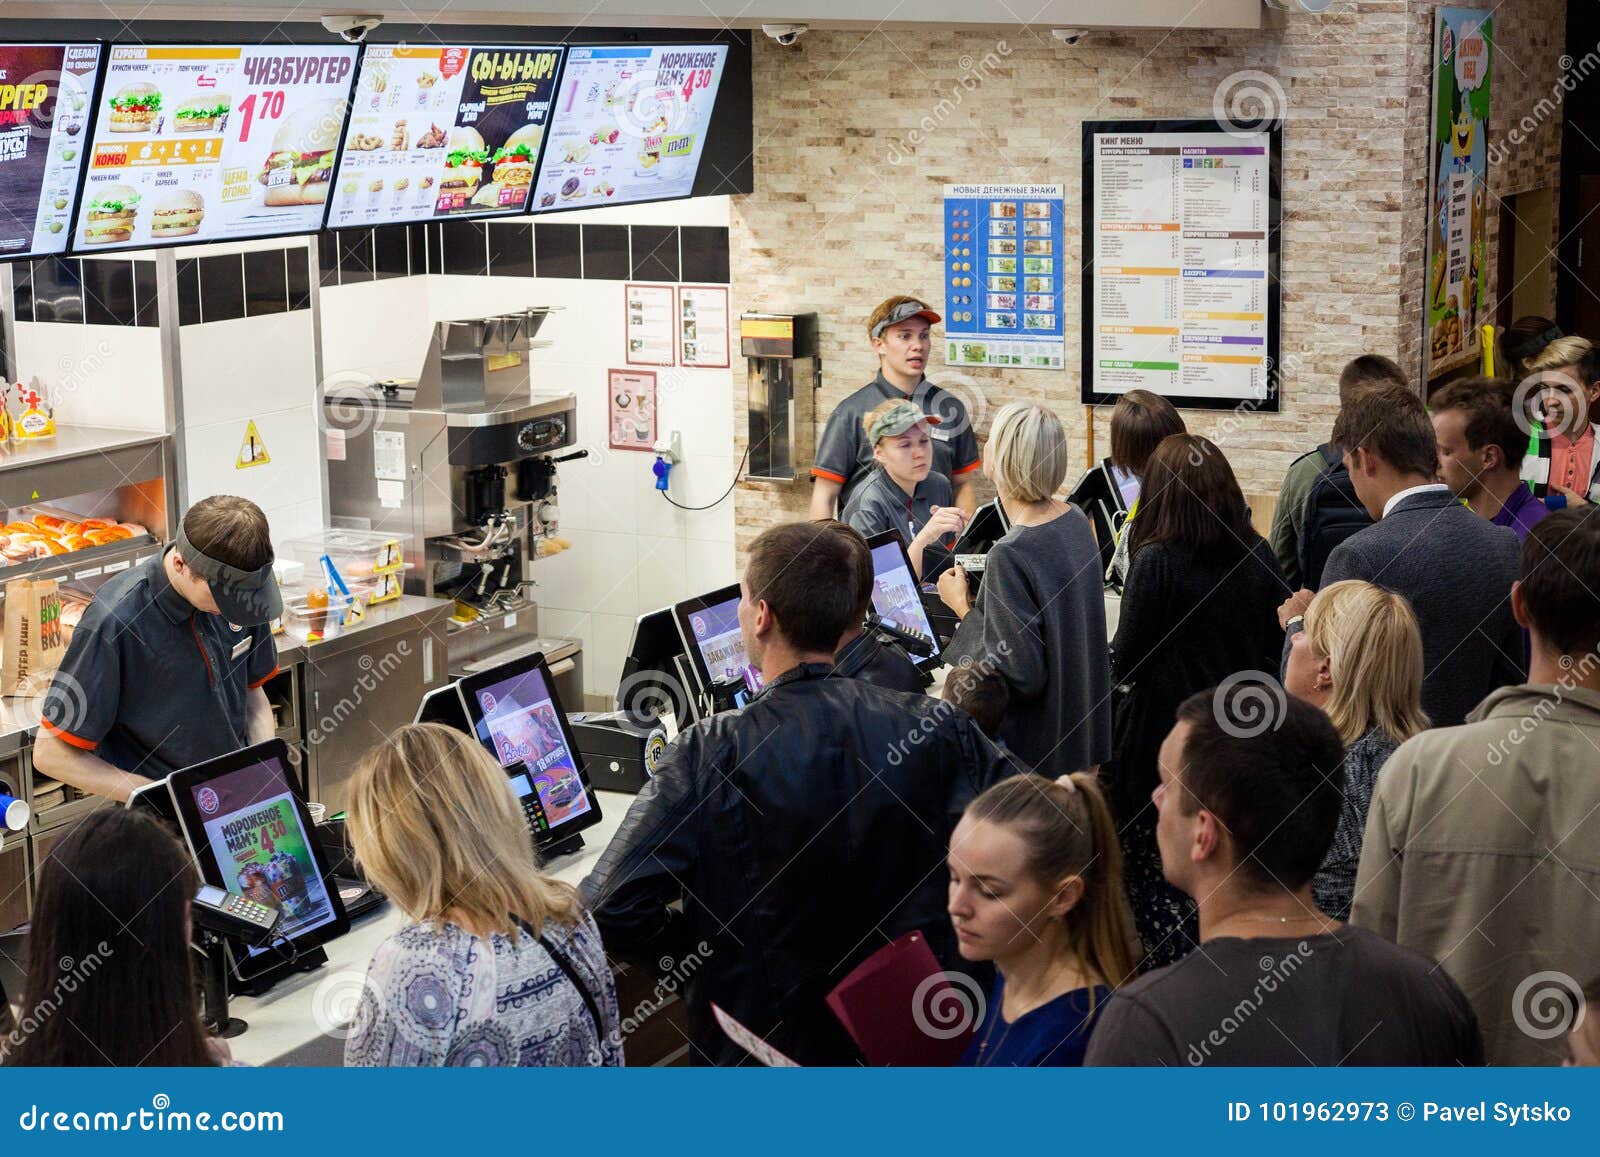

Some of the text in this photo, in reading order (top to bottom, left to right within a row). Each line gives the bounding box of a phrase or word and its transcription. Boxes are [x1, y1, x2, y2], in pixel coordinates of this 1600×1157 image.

[68, 47, 97, 60] СДЕЛАЙ
[658, 52, 718, 69] МОРОЖЕНОЕ
[243, 57, 351, 85] ЧИЗБУРГЕР
[1100, 137, 1144, 145] КИНГ МЕНЮ
[95, 153, 127, 166] КОМБО
[224, 170, 249, 186] ЦЕНА
[953, 186, 1057, 195] НОВЫЕ ДЕНЕЖНЫЕ ЗНАКИ
[221, 805, 282, 839] МОРОЖЕНОЕ
[225, 819, 287, 854] M&M's 4 30
